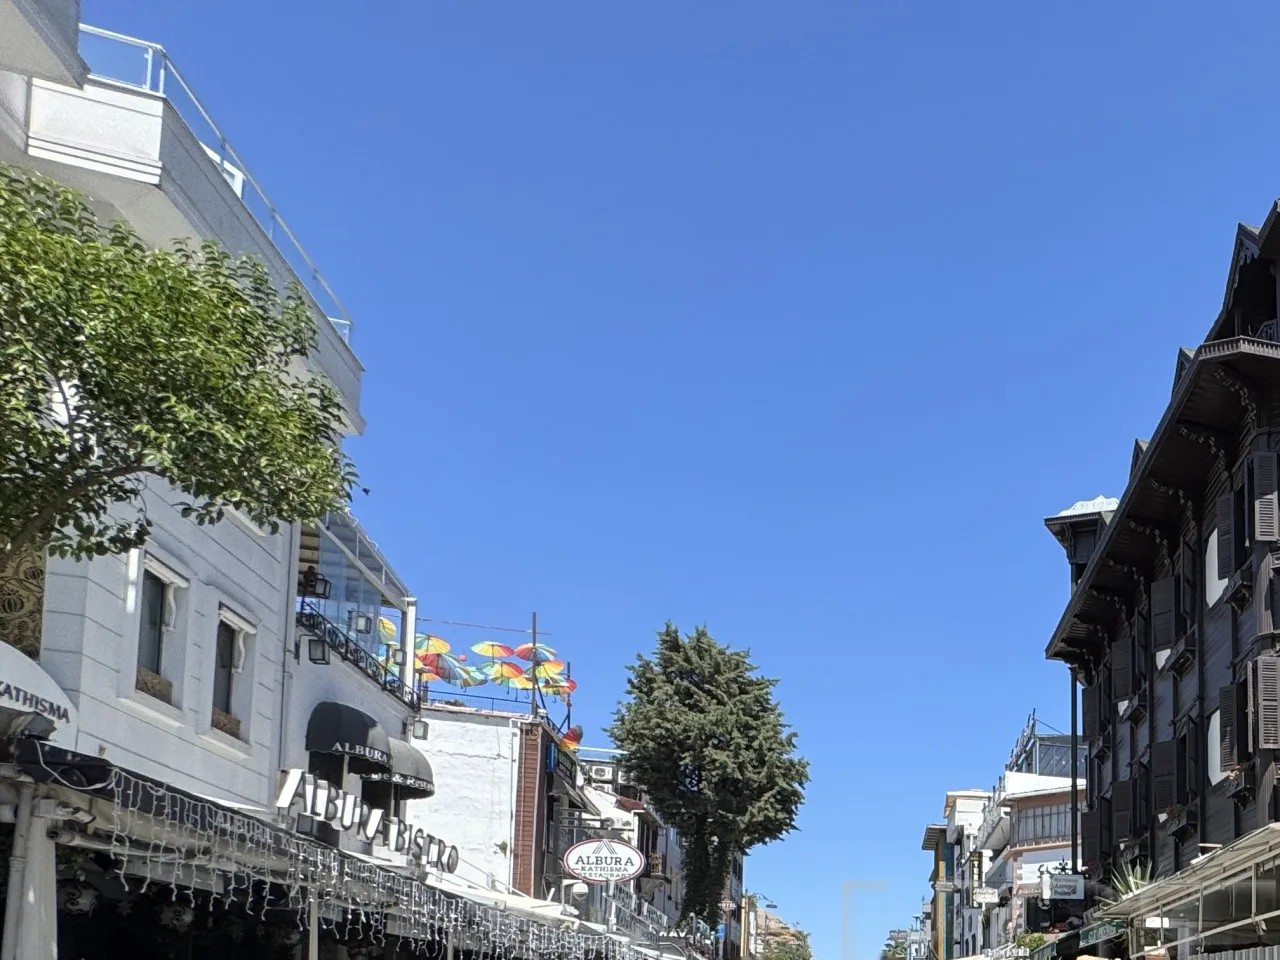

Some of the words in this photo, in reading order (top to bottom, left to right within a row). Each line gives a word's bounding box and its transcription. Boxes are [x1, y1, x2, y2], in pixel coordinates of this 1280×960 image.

[331, 742, 388, 763] ALBURA
[392, 773, 404, 783] &
[276, 768, 388, 846] ALBURA
[389, 816, 459, 874] BISTRO
[575, 855, 635, 866] ALBURA
